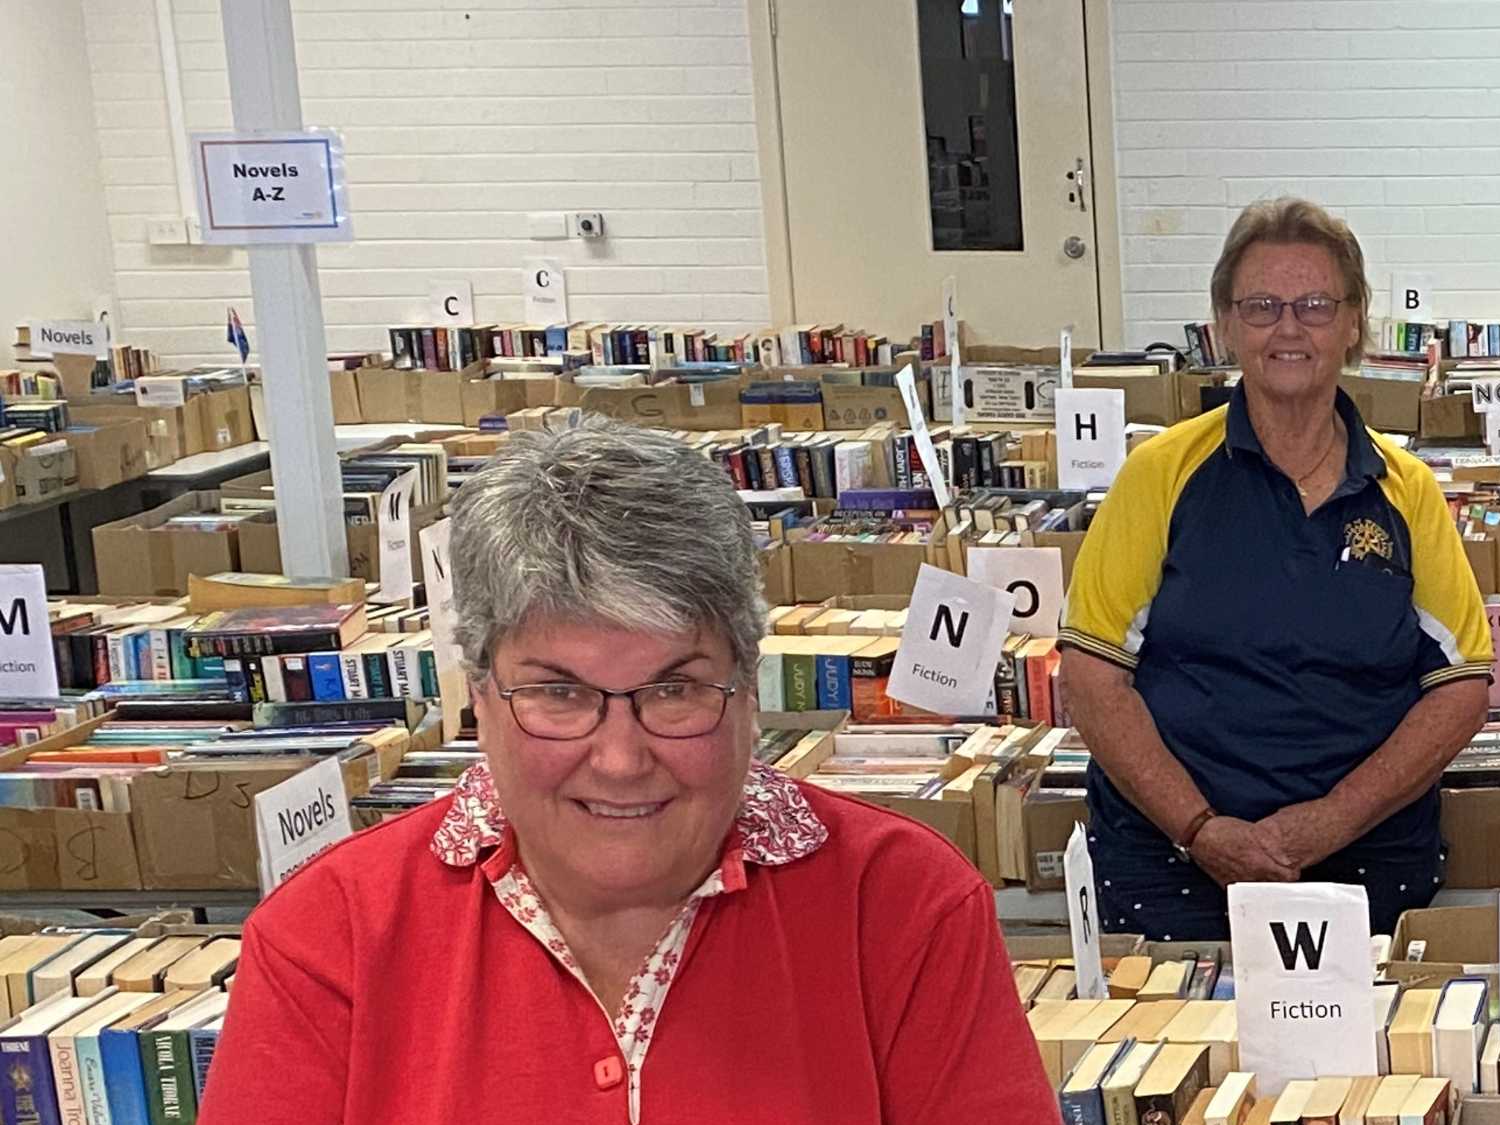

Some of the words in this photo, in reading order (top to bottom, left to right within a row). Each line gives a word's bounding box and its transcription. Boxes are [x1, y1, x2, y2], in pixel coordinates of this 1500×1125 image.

[232, 163, 299, 178] Novels
[252, 187, 286, 201] A-Z
[535, 269, 550, 288] C
[444, 296, 459, 316] C
[1404, 289, 1420, 310] B
[41, 327, 95, 346] Novels
[1074, 413, 1097, 440] H
[928, 604, 970, 649] N
[912, 664, 958, 689] Fiction
[277, 788, 336, 846] Novels
[1269, 920, 1329, 971] W
[1270, 1000, 1342, 1020] Fiction
[56, 1043, 77, 1102] Joanna
